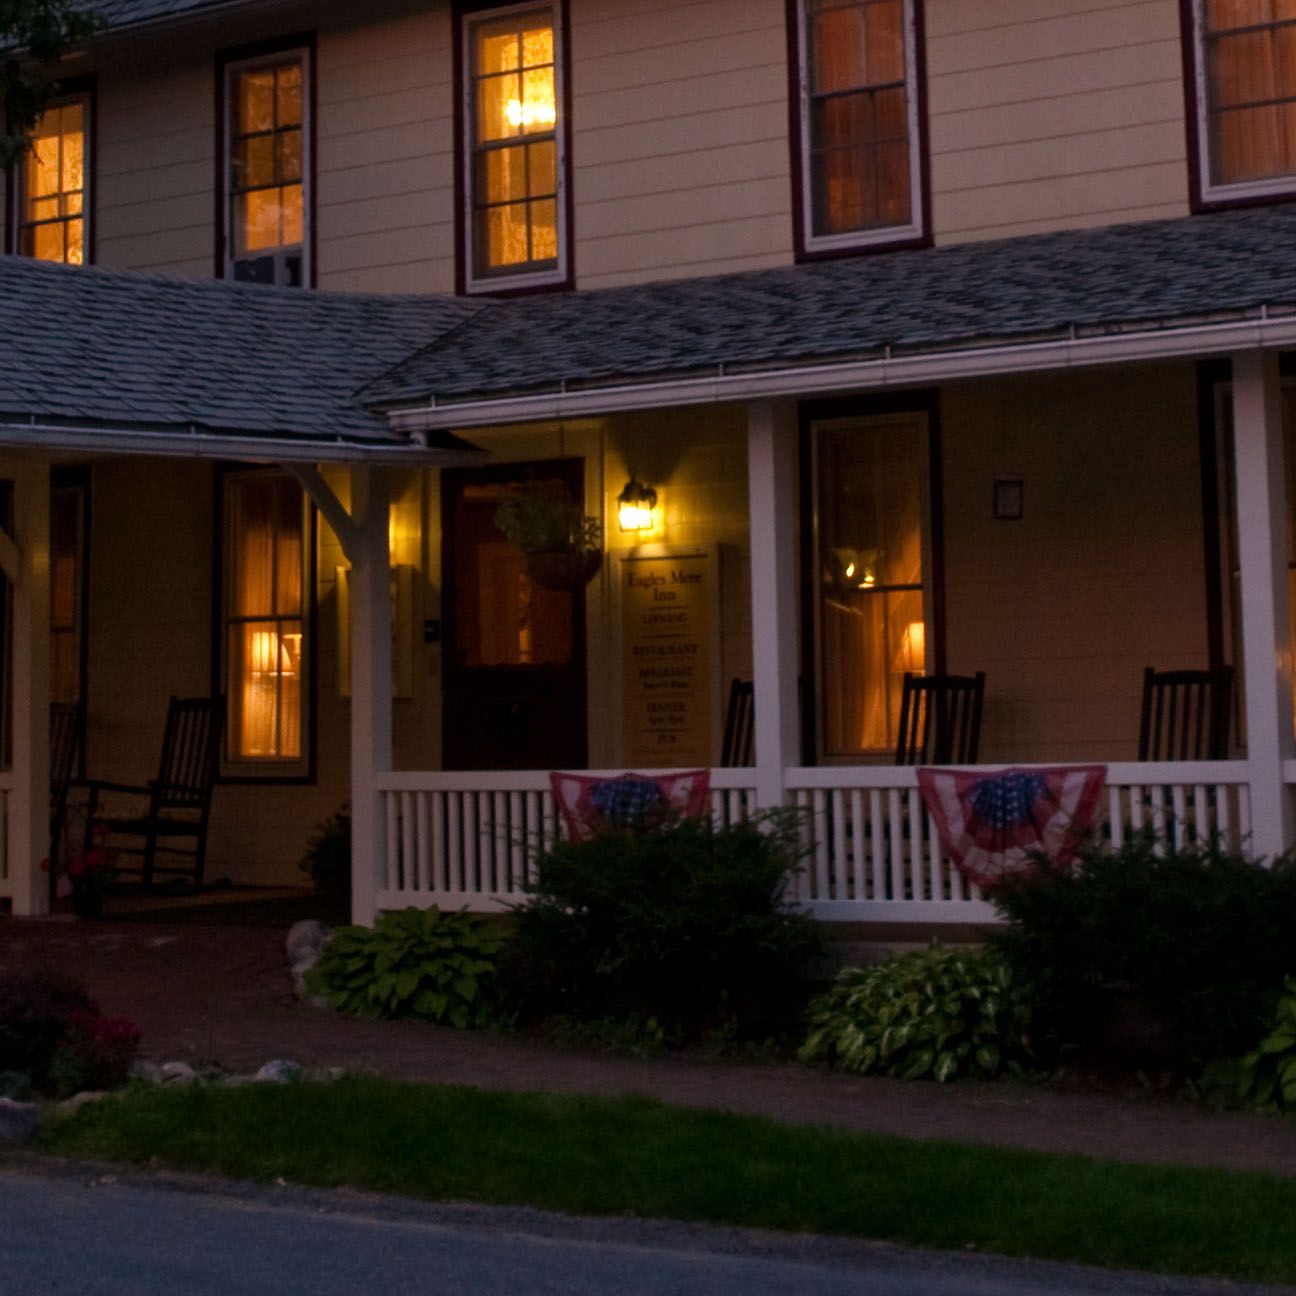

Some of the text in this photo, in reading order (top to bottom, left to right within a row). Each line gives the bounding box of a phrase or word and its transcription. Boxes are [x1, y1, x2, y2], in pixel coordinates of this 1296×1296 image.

[628, 570, 702, 588] Eagles Mere
[653, 589, 676, 601] Inn
